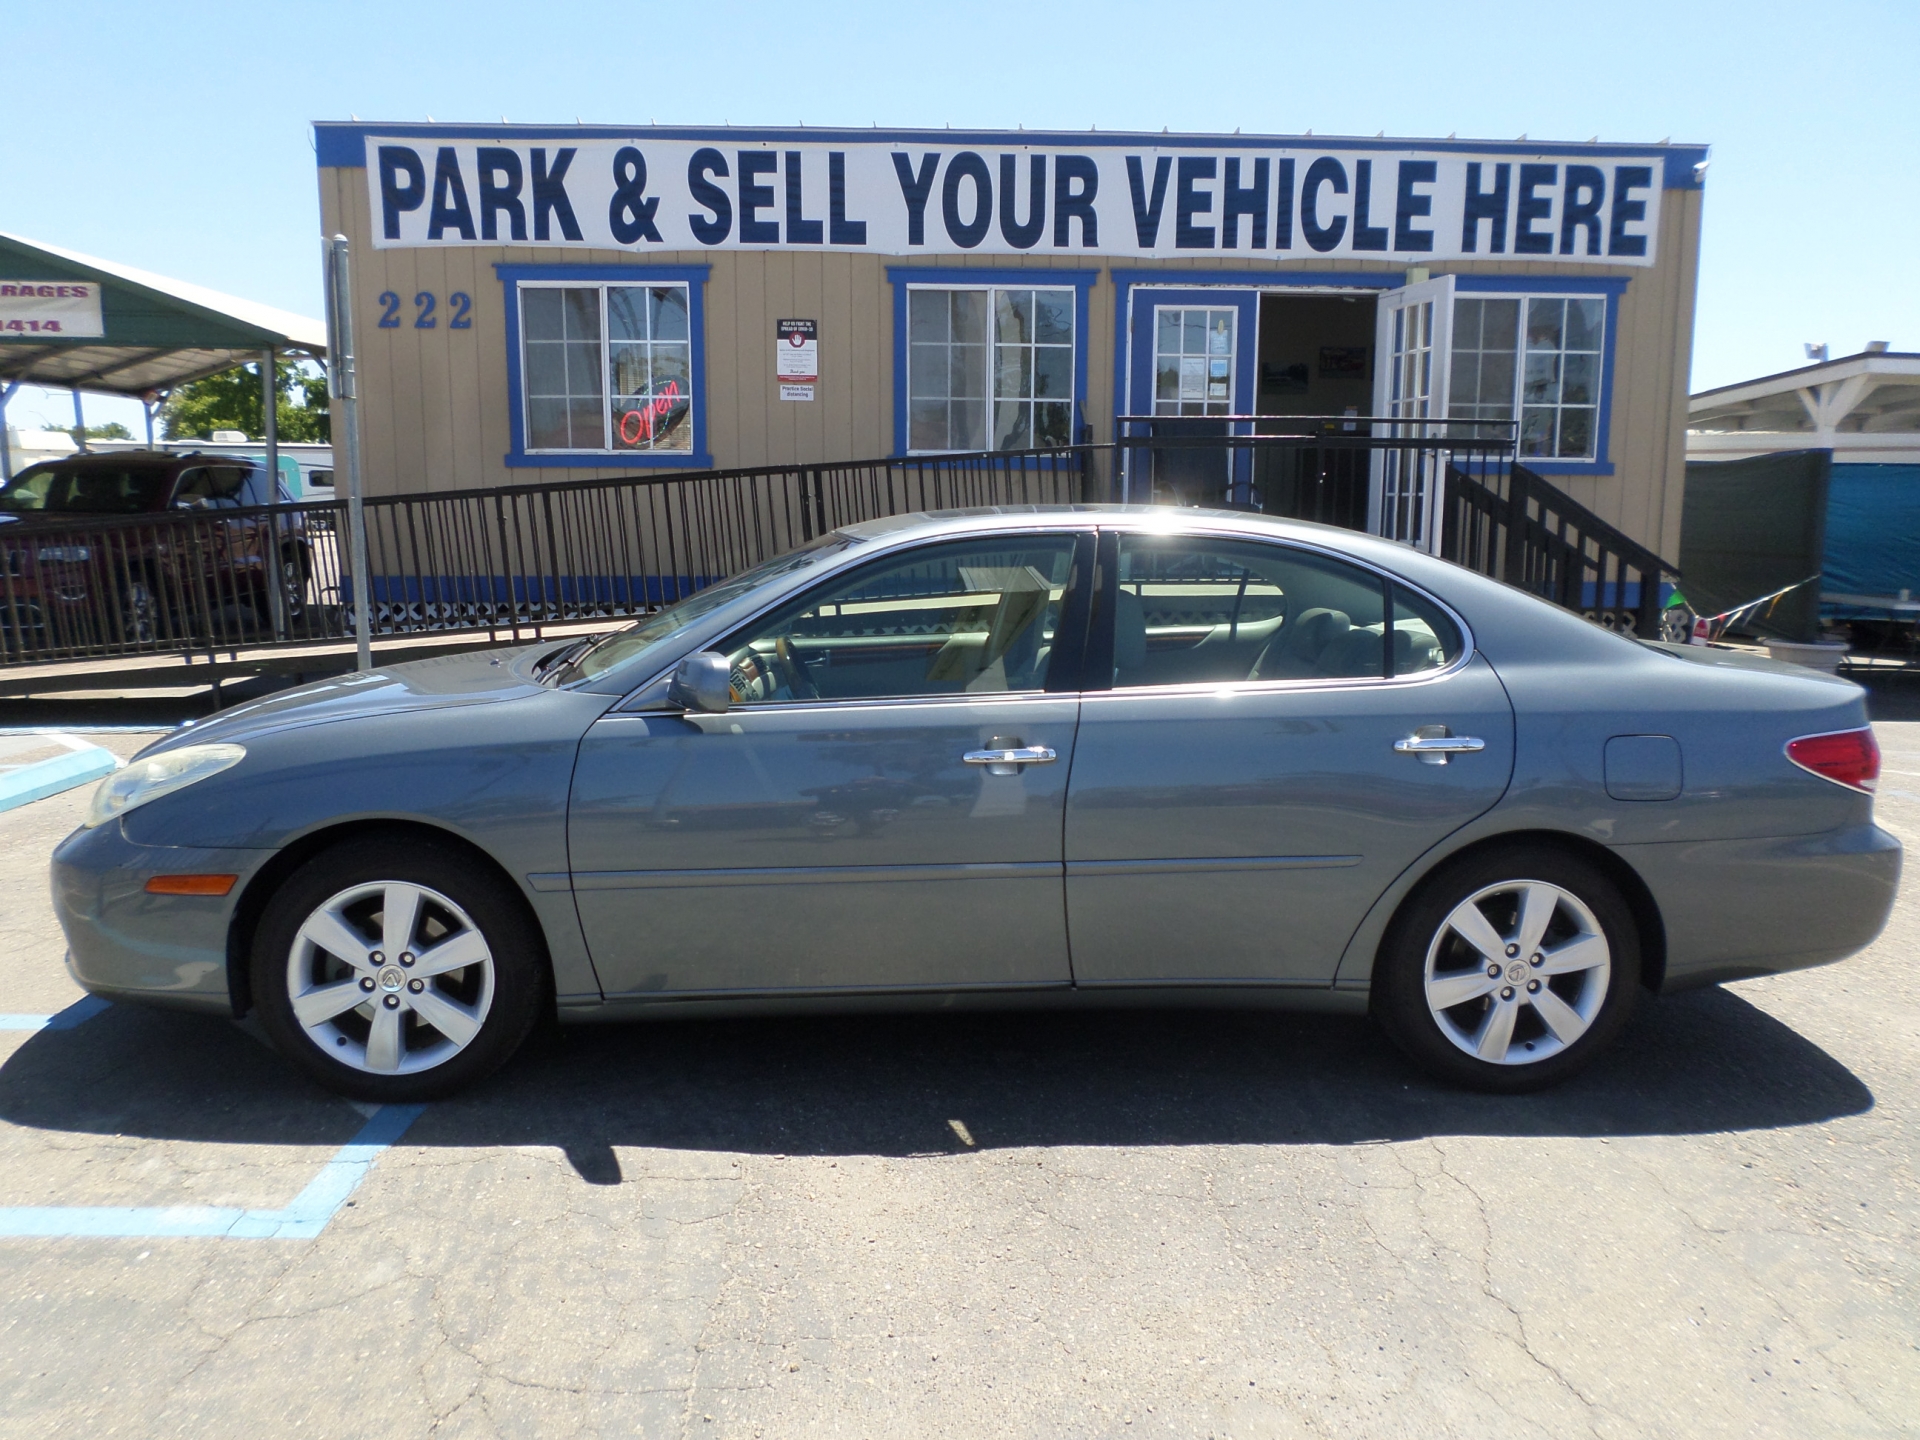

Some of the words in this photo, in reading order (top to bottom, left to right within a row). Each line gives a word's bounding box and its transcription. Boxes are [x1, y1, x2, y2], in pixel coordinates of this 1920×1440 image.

[378, 145, 584, 242] PARK
[608, 146, 665, 245] &
[687, 147, 868, 246] SELL
[890, 150, 1100, 250] YOUR
[1125, 155, 1437, 252] VEHICLE
[1461, 162, 1653, 257] HERE
[1, 285, 88, 298] RAGES
[377, 291, 472, 329] 222
[0, 320, 62, 332] 414
